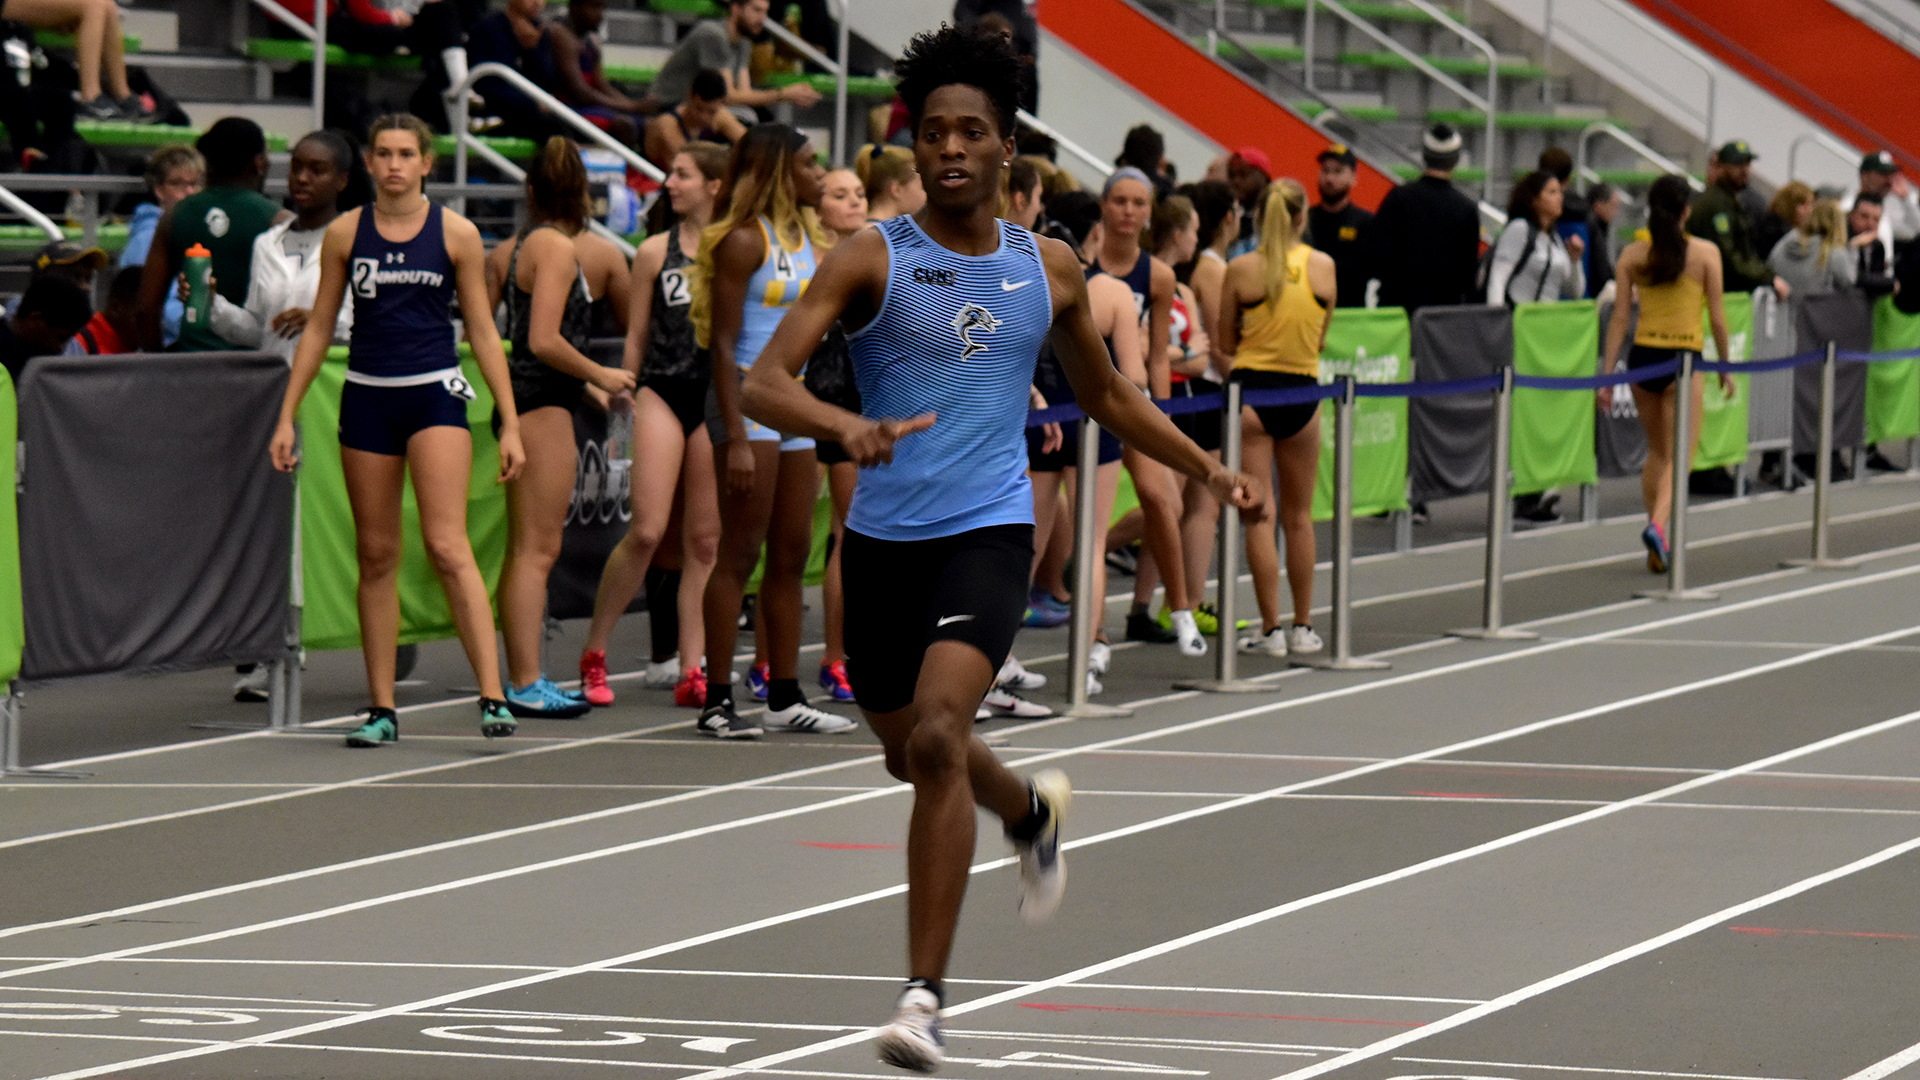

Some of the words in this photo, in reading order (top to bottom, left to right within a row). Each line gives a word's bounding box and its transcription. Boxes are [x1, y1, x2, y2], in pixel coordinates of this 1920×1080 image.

[356, 262, 371, 294] 2
[777, 249, 792, 278] 4
[376, 270, 444, 288] NMOUTH
[666, 272, 685, 302] 2
[449, 377, 474, 400] 2
